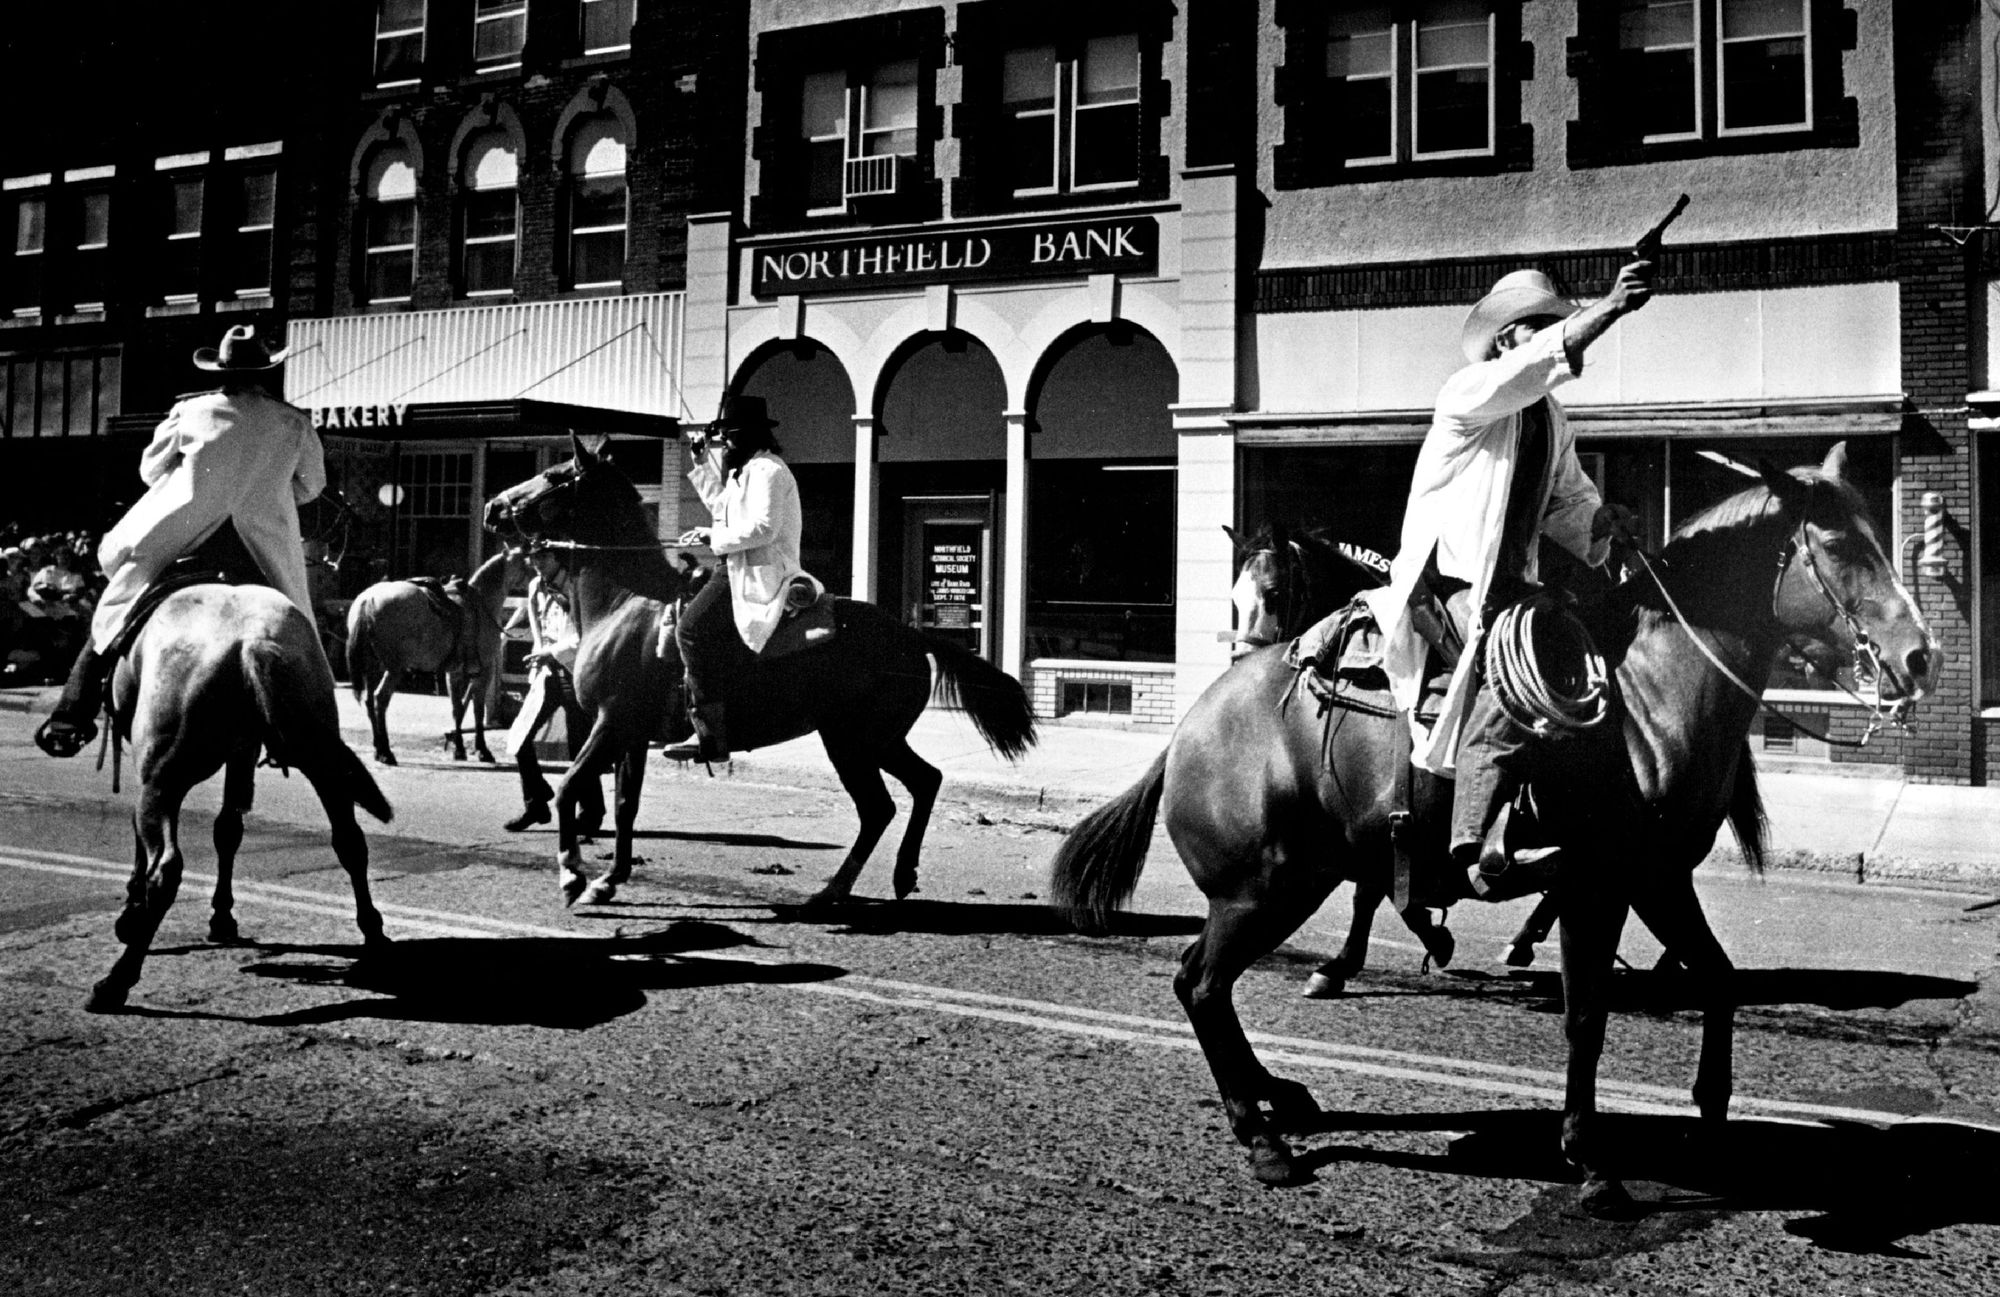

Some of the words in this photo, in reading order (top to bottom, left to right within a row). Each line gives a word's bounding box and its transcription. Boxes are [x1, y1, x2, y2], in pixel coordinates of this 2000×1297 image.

[761, 238, 991, 283] NORTHFIELD
[1031, 226, 1144, 264] BANK
[311, 404, 408, 429] BAKERY
[934, 545, 971, 553] NORTHFIELD
[935, 564, 969, 573] MUSEUM
